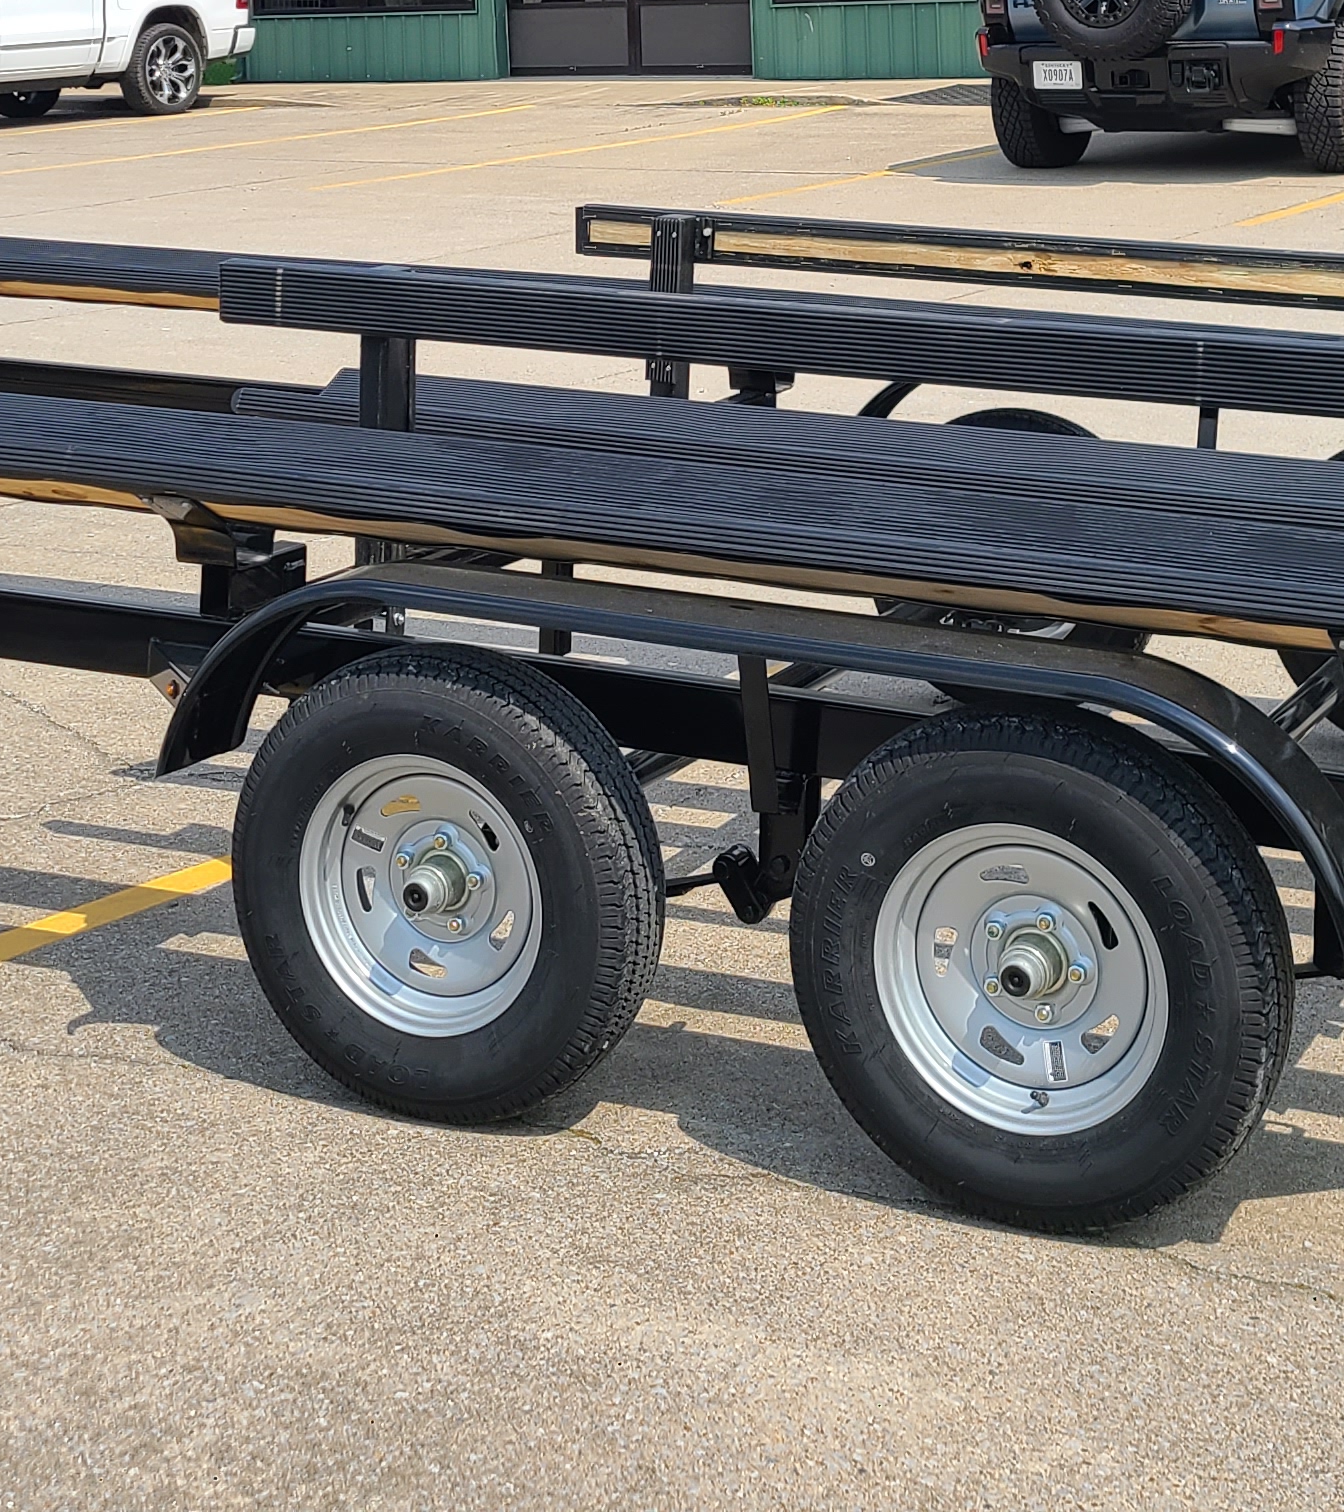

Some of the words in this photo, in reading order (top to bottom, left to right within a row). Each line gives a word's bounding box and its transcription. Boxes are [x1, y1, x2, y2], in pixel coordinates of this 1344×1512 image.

[1042, 68, 1074, 82] X0907A
[818, 863, 865, 1057] KARRIER
[1150, 875, 1214, 986] LOAD
